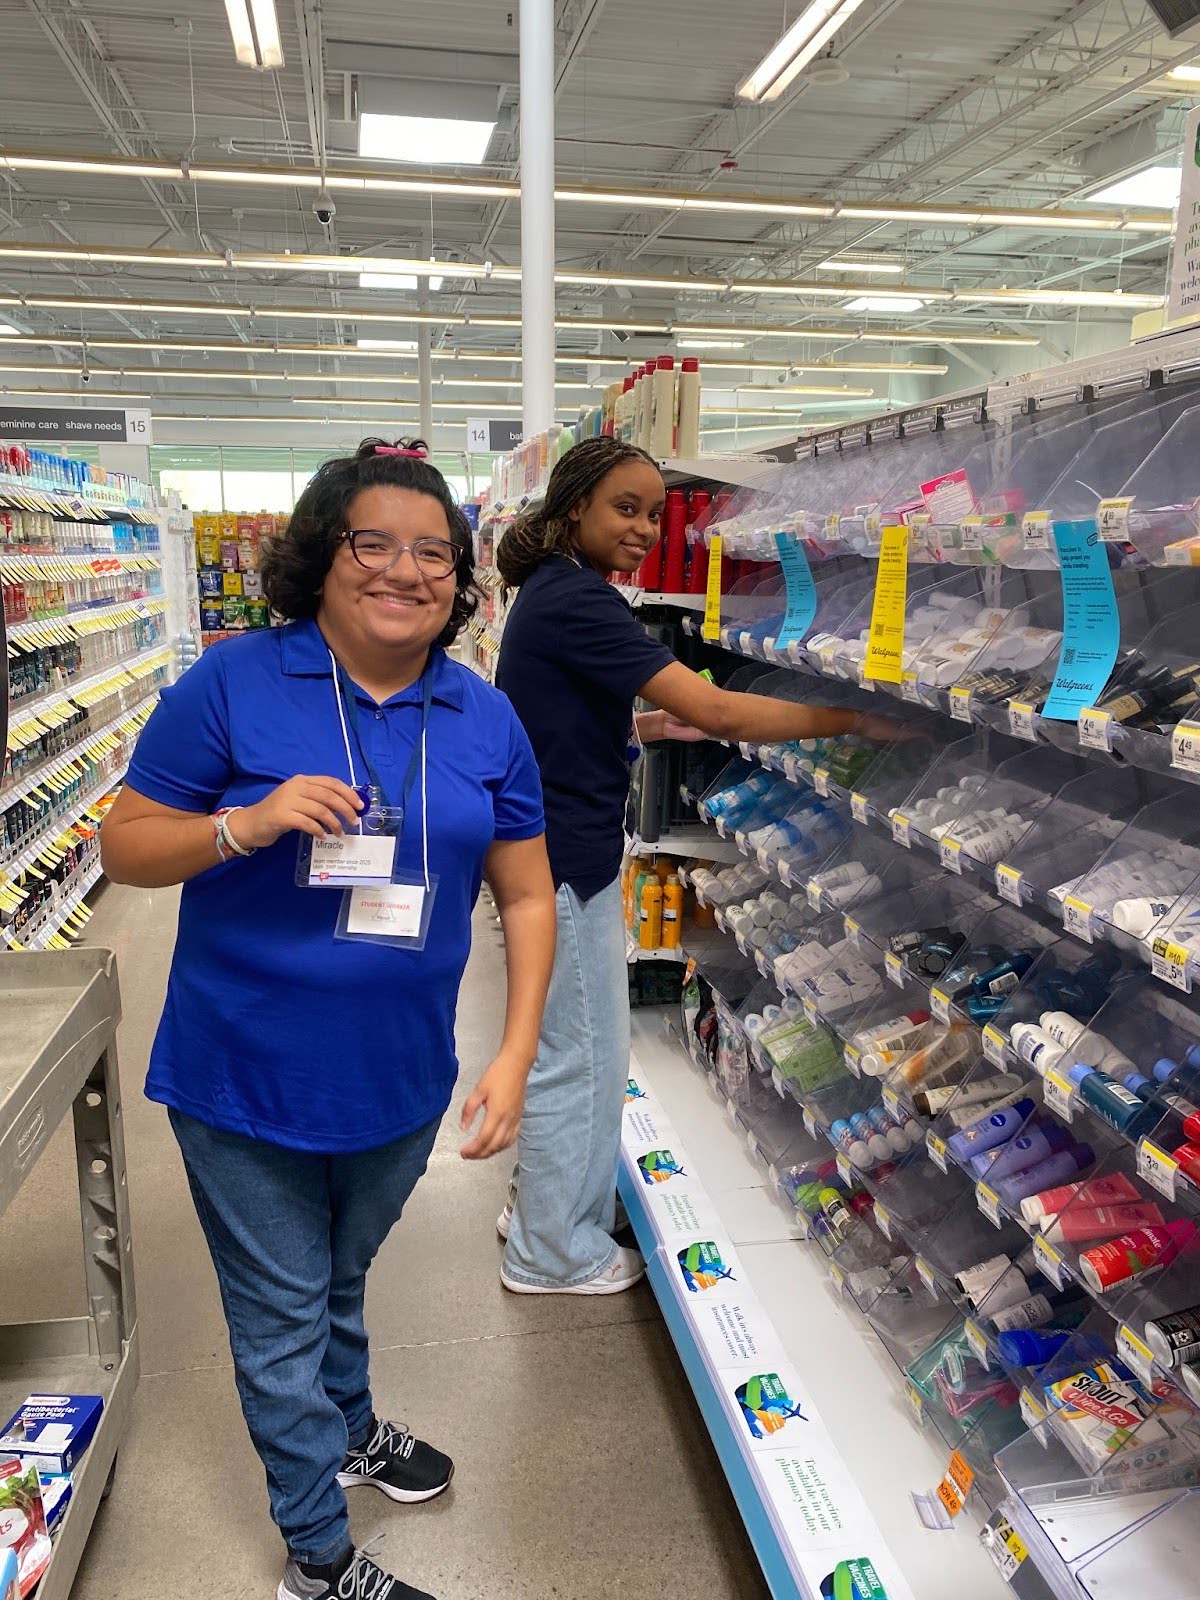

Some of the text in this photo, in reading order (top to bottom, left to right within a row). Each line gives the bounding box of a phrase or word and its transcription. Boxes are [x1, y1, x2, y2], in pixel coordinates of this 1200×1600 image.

[38, 421, 59, 430] care
[65, 420, 92, 430] shave
[94, 421, 122, 431] needs
[129, 420, 146, 433] 15
[471, 429, 486, 442] 14
[1056, 678, 1094, 693] Walgreens
[315, 840, 344, 850] Miracle
[360, 901, 411, 911] STUDENT WORKER
[759, 1376, 777, 1400] VACCINES
[771, 1377, 784, 1395] TRAVEL
[21, 1411, 44, 1419] Gauze
[24, 1406, 77, 1414] Antibacterial
[1098, 1407, 1110, 1418] &
[1108, 1412, 1128, 1425] Go
[774, 1457, 819, 1536] pharmacy today.
[791, 1459, 831, 1532] available in our
[805, 1457, 843, 1530] Travel vaccines
[939, 1482, 952, 1502] NOW
[848, 1562, 872, 1599] VACCINES
[861, 1564, 882, 1591] TRAVEL
